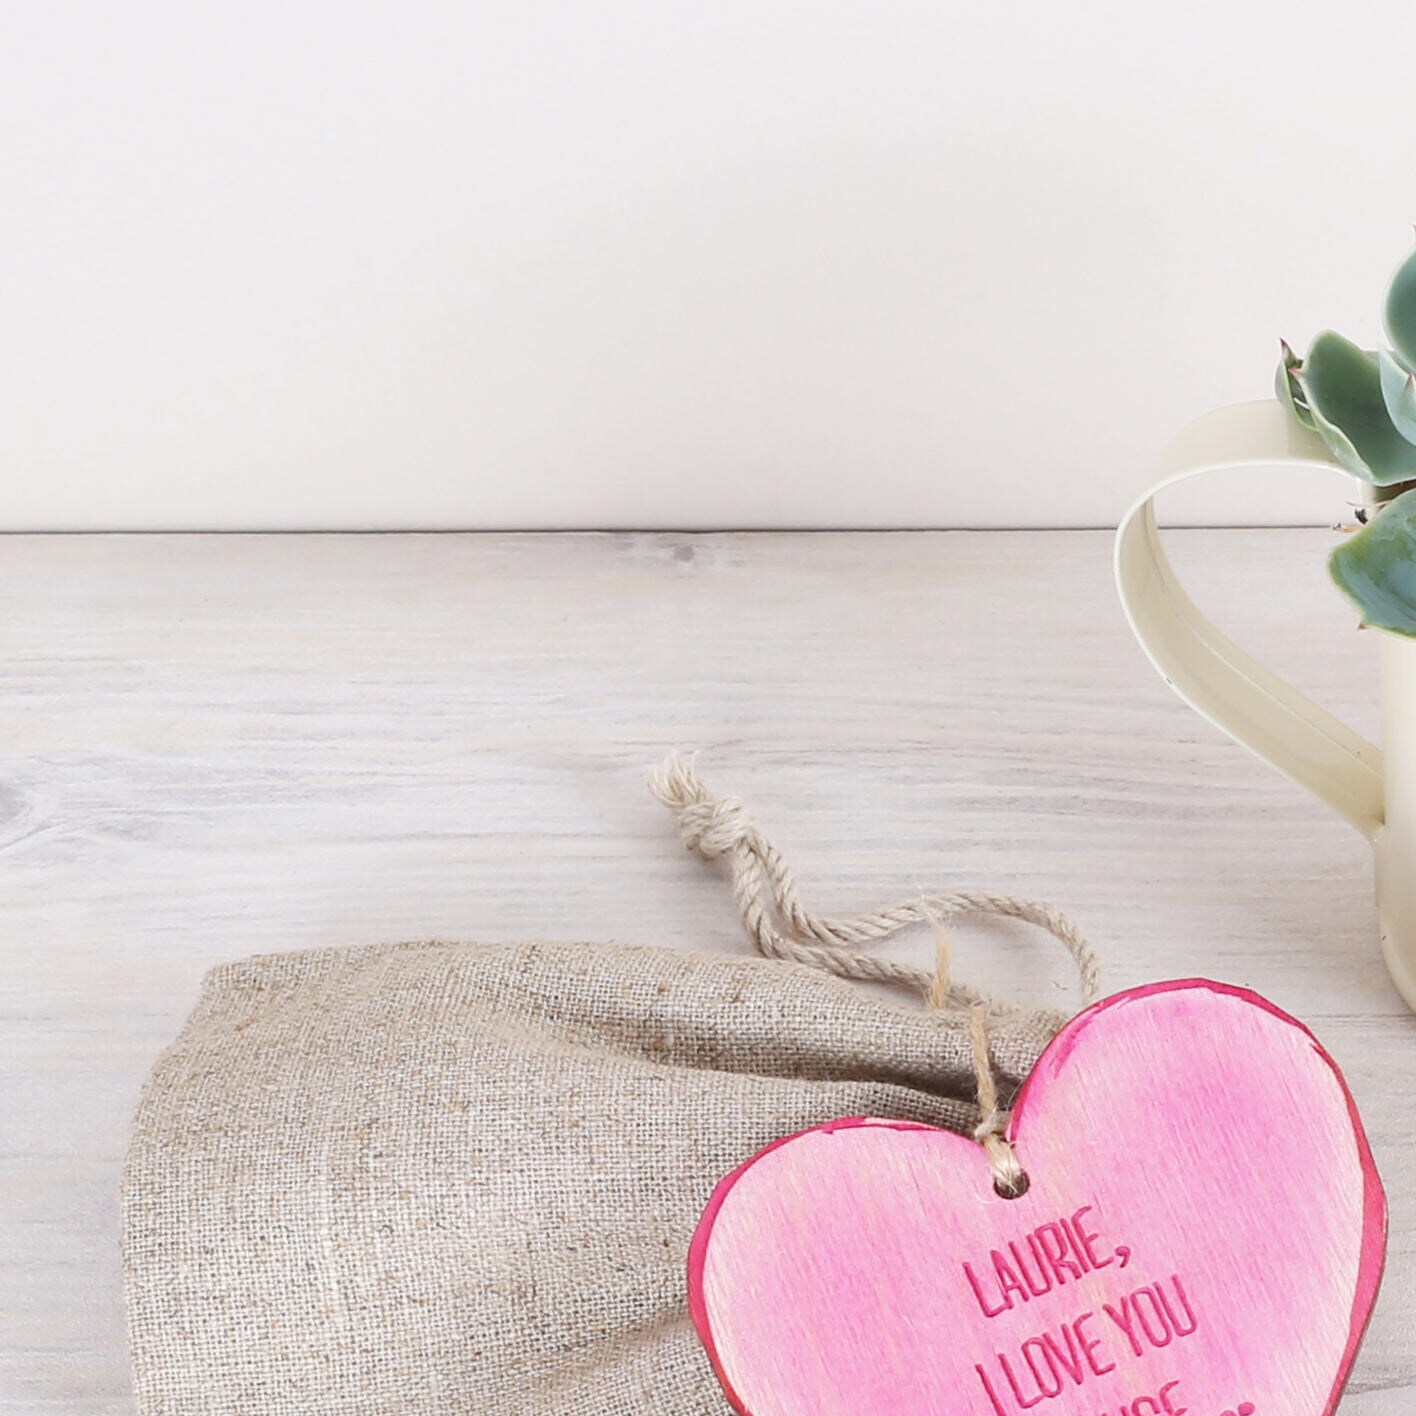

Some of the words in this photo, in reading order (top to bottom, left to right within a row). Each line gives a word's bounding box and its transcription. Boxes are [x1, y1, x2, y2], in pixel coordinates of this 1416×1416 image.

[962, 1205, 1131, 1318] LAURIE,
[998, 1312, 1116, 1408] LOVE
[1103, 1273, 1197, 1356] YOU
